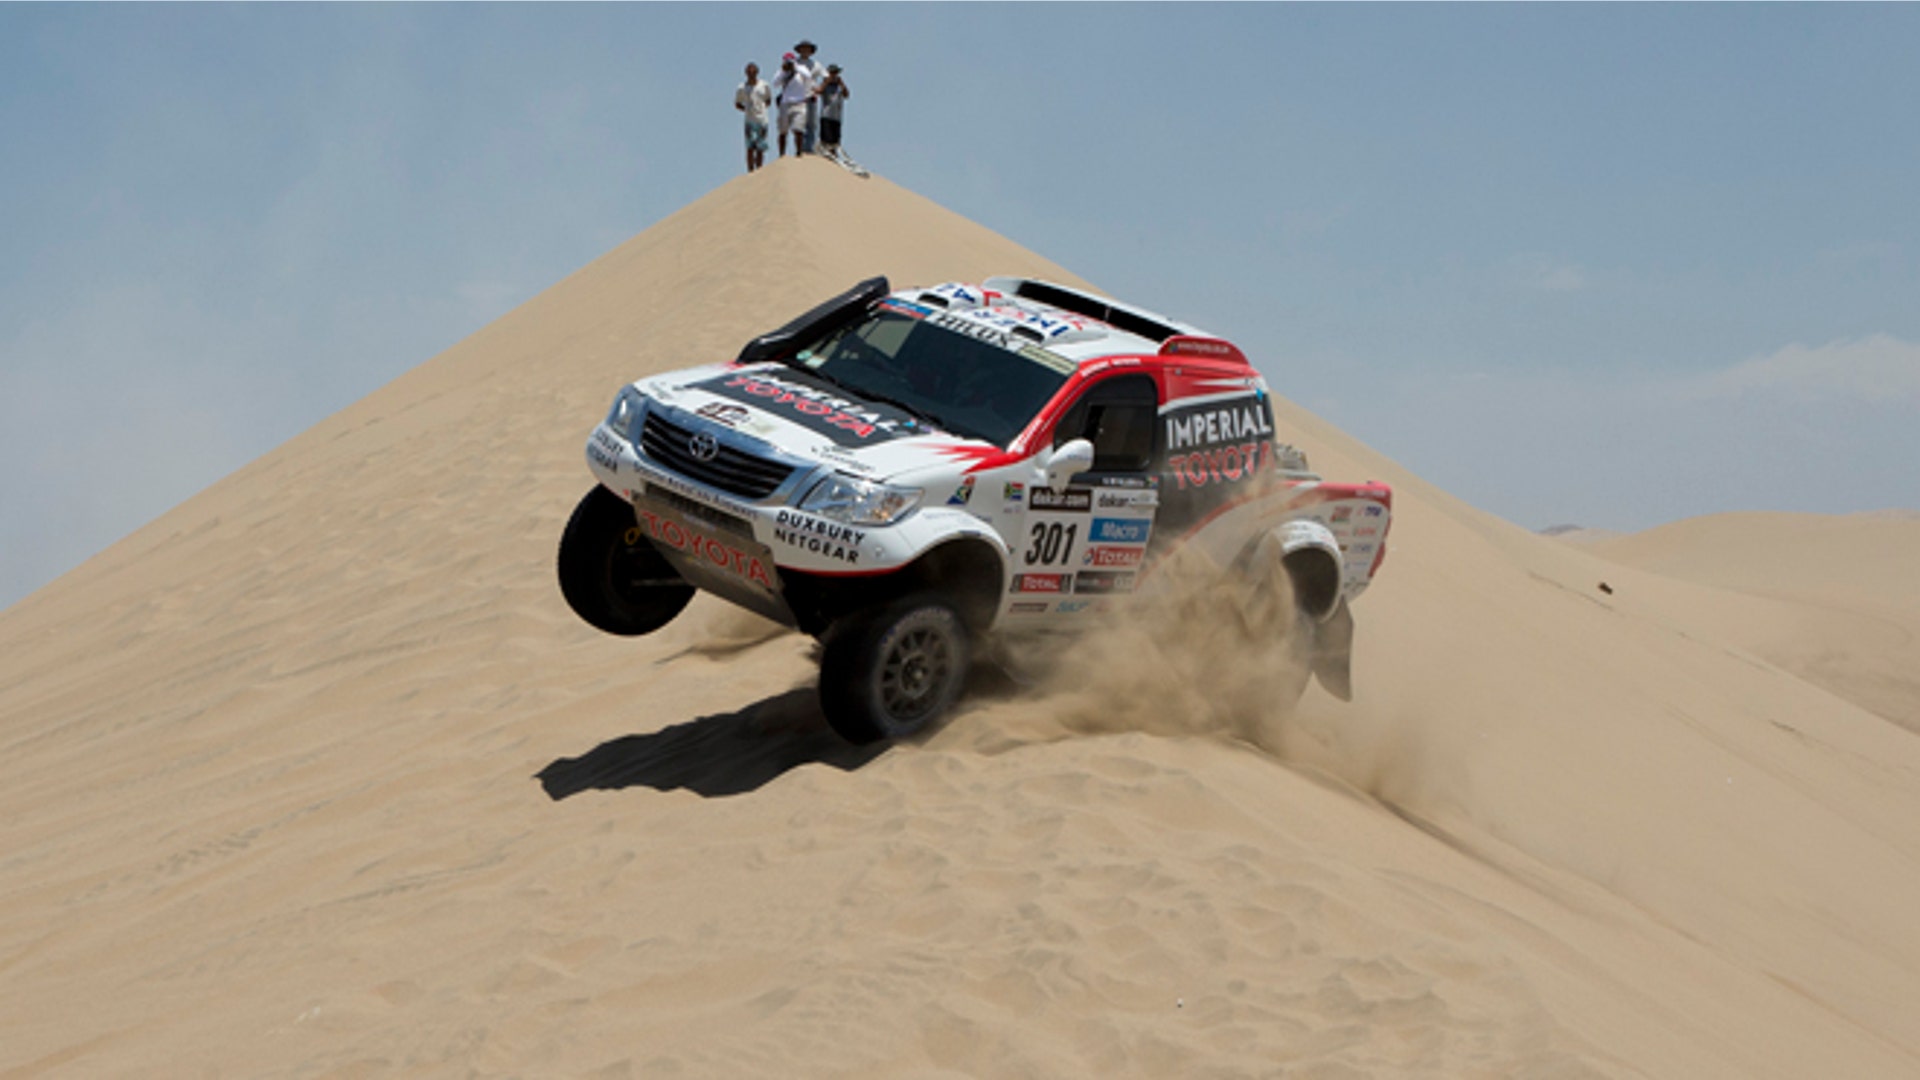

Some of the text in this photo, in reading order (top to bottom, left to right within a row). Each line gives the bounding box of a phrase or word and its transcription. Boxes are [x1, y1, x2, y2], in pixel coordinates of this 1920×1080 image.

[724, 376, 876, 438] TOYOTA
[1166, 404, 1273, 450] IMPERIAL
[1168, 440, 1276, 490] TOYOTA
[774, 529, 860, 565] NETGEAR
[776, 510, 866, 546] DUXBURY
[1025, 522, 1078, 565] 301
[1102, 522, 1139, 539] Macro
[640, 510, 773, 588] TOYOTA
[1099, 548, 1138, 564] TOTAL
[1023, 575, 1060, 590] TOTAL
